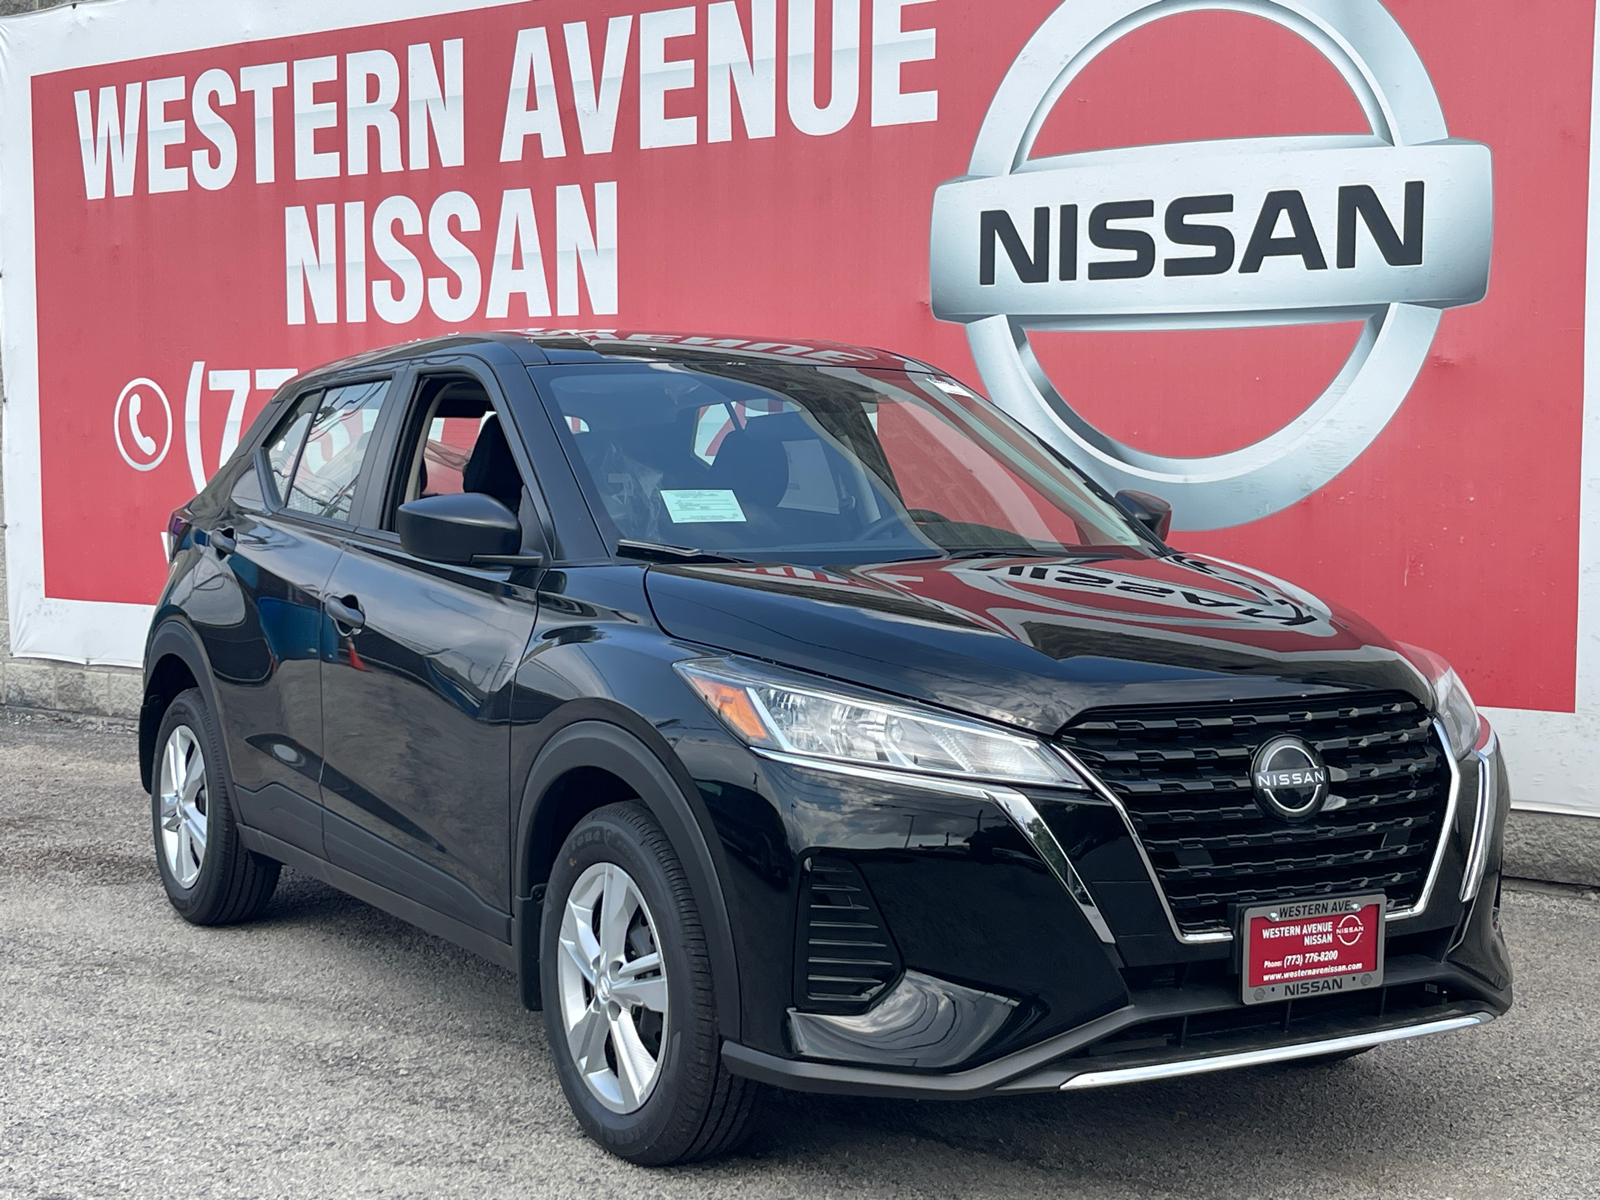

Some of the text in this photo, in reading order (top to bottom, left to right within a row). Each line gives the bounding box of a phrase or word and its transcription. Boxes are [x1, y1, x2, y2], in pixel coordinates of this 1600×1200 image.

[74, 0, 938, 200] WESTERN AVENUE
[979, 180, 1425, 286] NISSAN
[285, 181, 619, 325] NISSAN
[1258, 771, 1324, 786] NISSAN
[1279, 902, 1328, 918] WESTERN
[1262, 922, 1333, 939] WESTERN AVENUE
[1336, 926, 1364, 934] NISSAN
[1304, 933, 1333, 946] NISSAN
[1264, 950, 1338, 968] Phone: (773) 776-8200
[1263, 963, 1363, 981] www.westernavenissan.com
[1284, 978, 1343, 996] NISSAN
